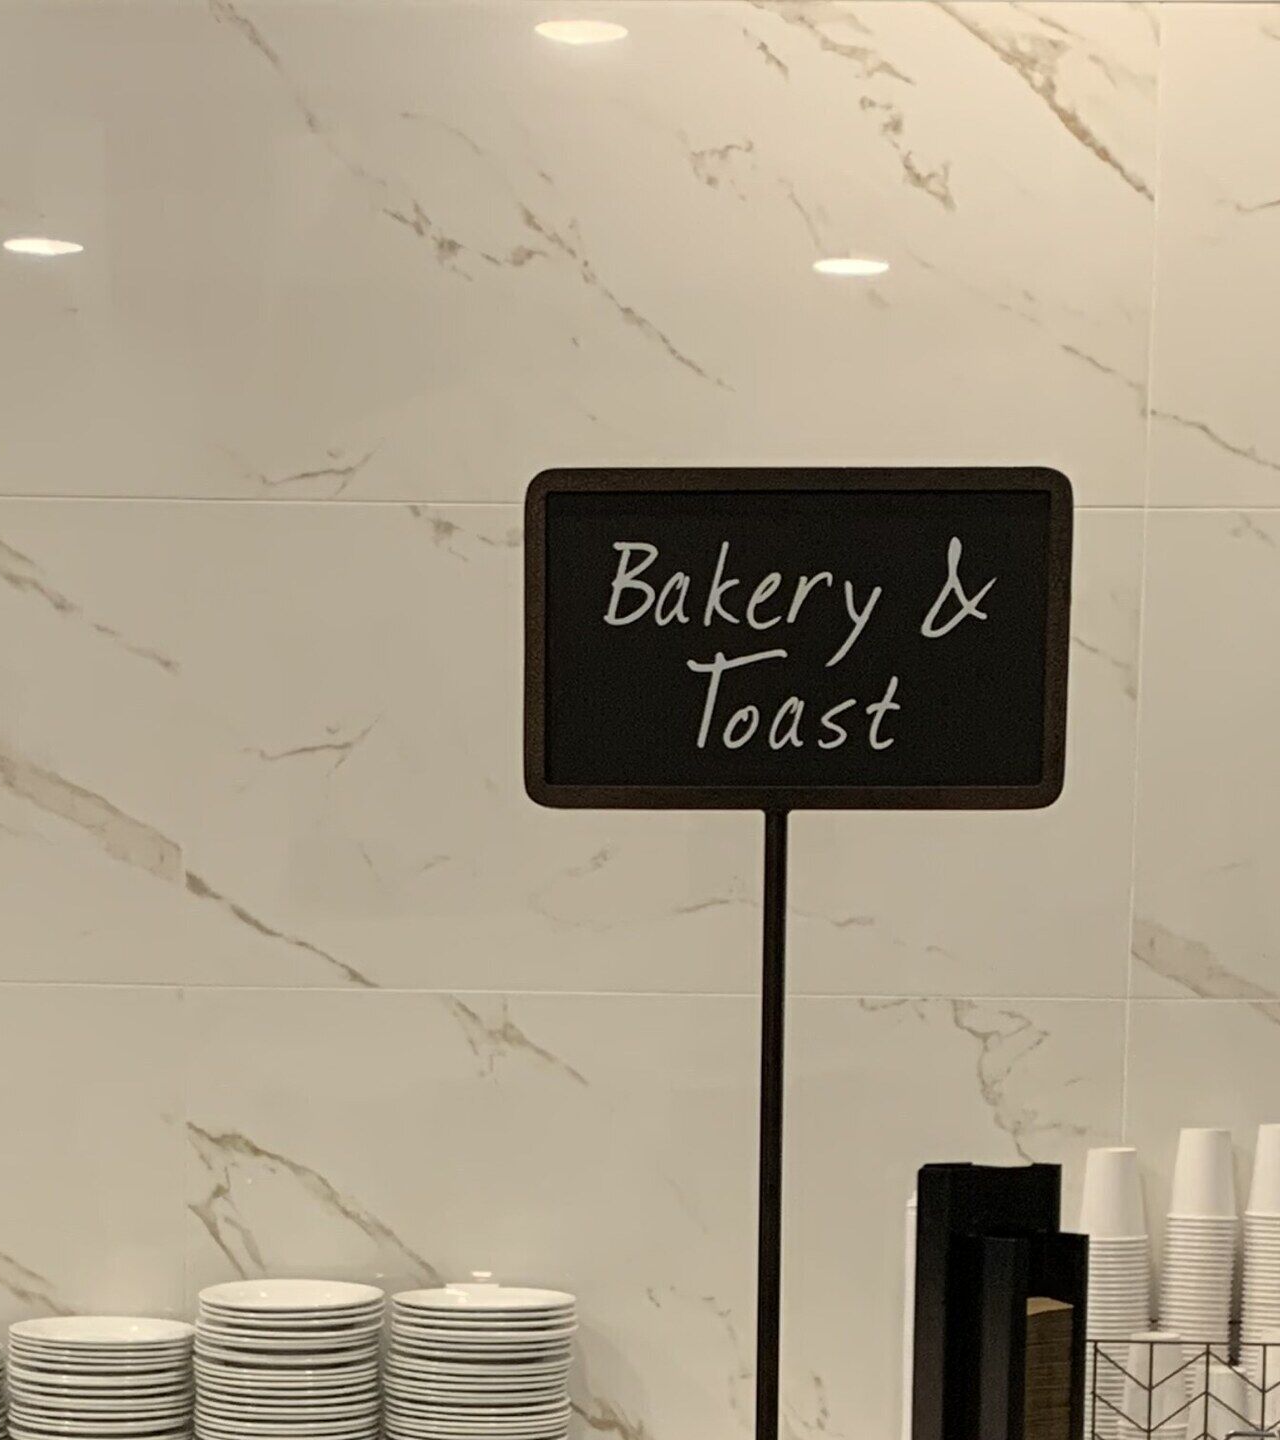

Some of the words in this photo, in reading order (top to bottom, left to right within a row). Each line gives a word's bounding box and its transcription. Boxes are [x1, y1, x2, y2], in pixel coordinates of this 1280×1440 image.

[604, 541, 881, 667] Bakery
[921, 537, 996, 637] &
[687, 648, 900, 750] Toast
